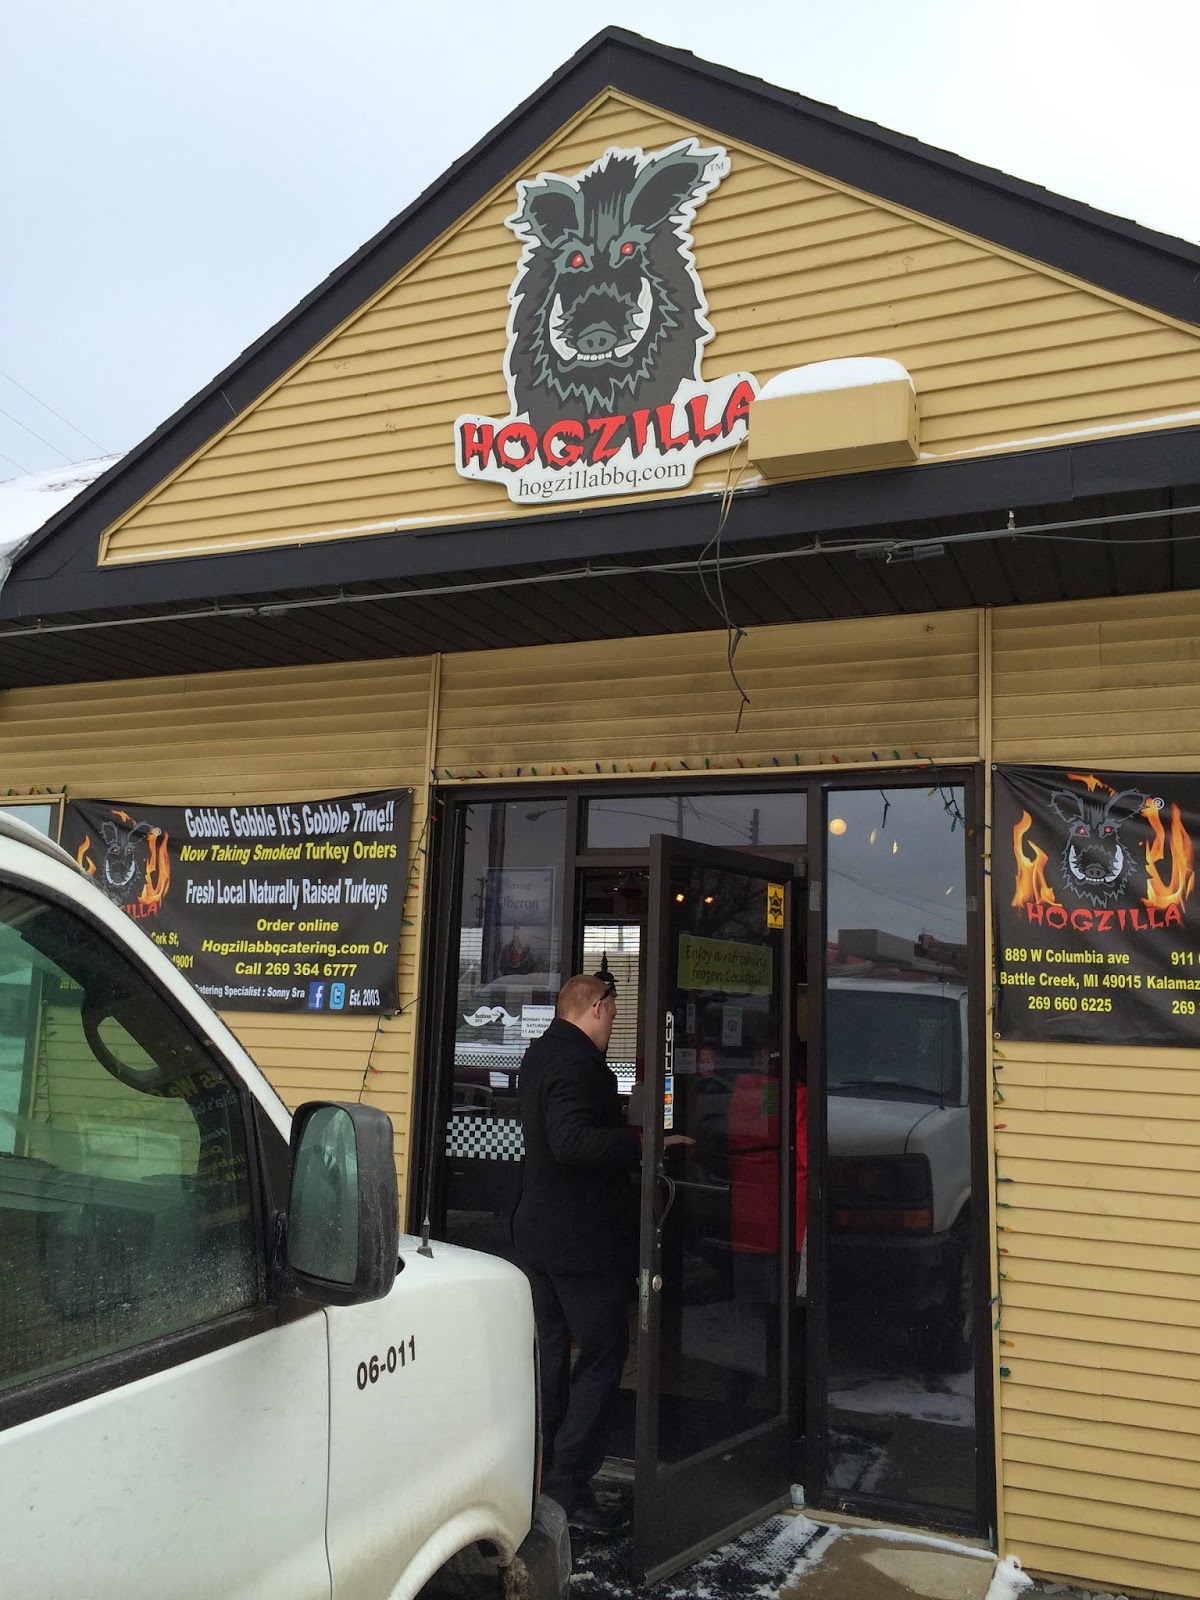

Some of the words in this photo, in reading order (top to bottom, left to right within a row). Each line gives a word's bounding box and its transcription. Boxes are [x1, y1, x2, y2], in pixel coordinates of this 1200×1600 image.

[460, 381, 755, 472] HOGZILLA
[519, 461, 687, 498] hogzillabbq.com
[184, 808, 230, 838] Gobble
[230, 807, 277, 837] Gobble
[277, 806, 301, 836] It's
[302, 804, 350, 835] Gobble
[352, 800, 395, 832] Time!!
[180, 845, 208, 861] Now
[211, 844, 251, 865] Taking
[253, 843, 303, 860] Smoked
[305, 841, 350, 864] Turkey
[353, 840, 397, 859] Orders
[186, 879, 214, 904] Fresh
[217, 879, 246, 904] Local
[249, 878, 299, 910] Naturally
[302, 878, 342, 904] Raised
[344, 878, 388, 910] Turkeys
[256, 919, 295, 932] Order
[298, 919, 339, 932] online
[1026, 902, 1182, 932] HOGZILLA
[168, 932, 179, 947] St,
[201, 940, 370, 957] Hogzillabbqcatering.com
[373, 941, 388, 955] Or
[1005, 948, 1027, 961] 889
[1030, 949, 1042, 962] W
[1045, 949, 1103, 964] Columbia
[1107, 953, 1130, 964] ave
[1171, 952, 1193, 966] 911
[235, 962, 262, 975] Call
[265, 962, 290, 976] 269
[293, 963, 320, 976] 364
[323, 963, 357, 977] 6777
[1000, 971, 1036, 985] Battle
[1039, 972, 1080, 990] Creek,
[1083, 974, 1098, 987] MI
[1102, 974, 1142, 988] 49015
[224, 985, 261, 999] Specialist
[267, 987, 290, 1000] Sonny
[292, 987, 305, 998] Sra
[362, 989, 380, 1006] 2003
[1028, 996, 1051, 1010] 269
[1054, 997, 1077, 1010] 660
[1081, 997, 1112, 1012] 6225
[1172, 1000, 1195, 1015] 269
[357, 1334, 416, 1391] 06-011
